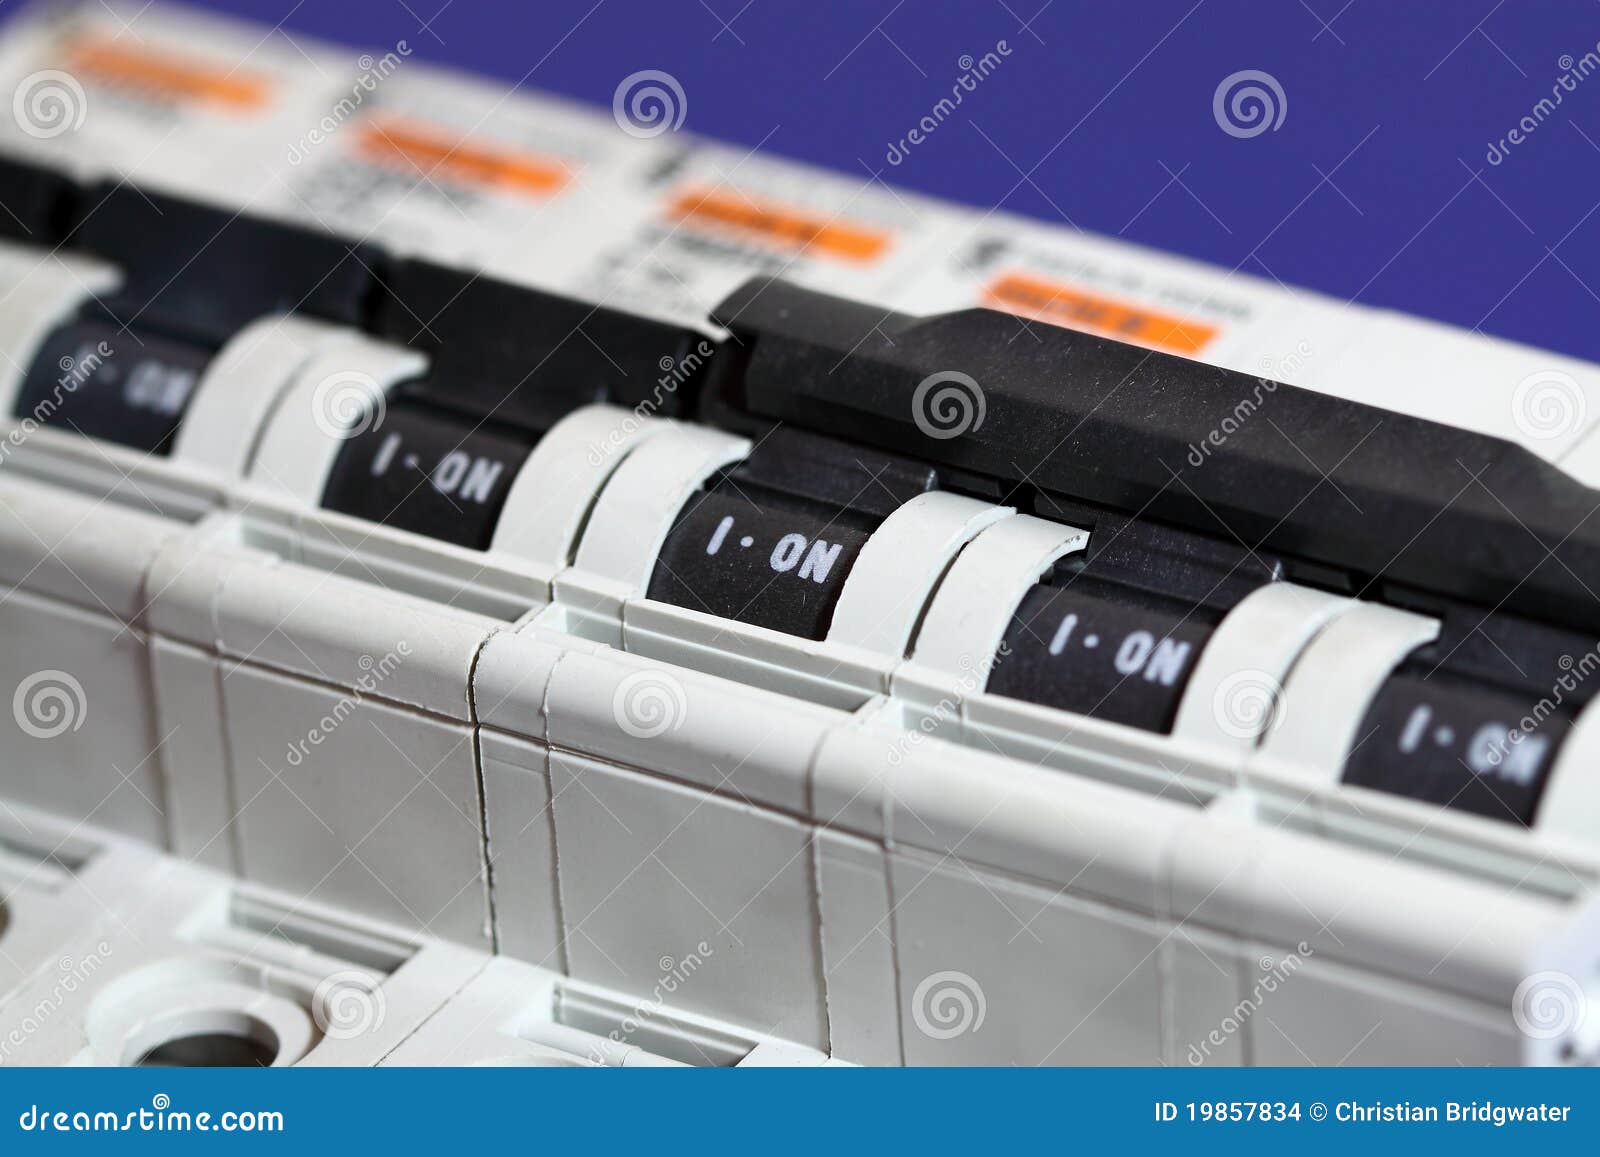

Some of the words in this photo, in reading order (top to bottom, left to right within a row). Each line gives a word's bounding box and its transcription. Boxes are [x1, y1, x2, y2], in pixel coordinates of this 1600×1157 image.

[432, 451, 503, 504] ON
[769, 532, 844, 584] ON
[1113, 629, 1192, 686] ON
